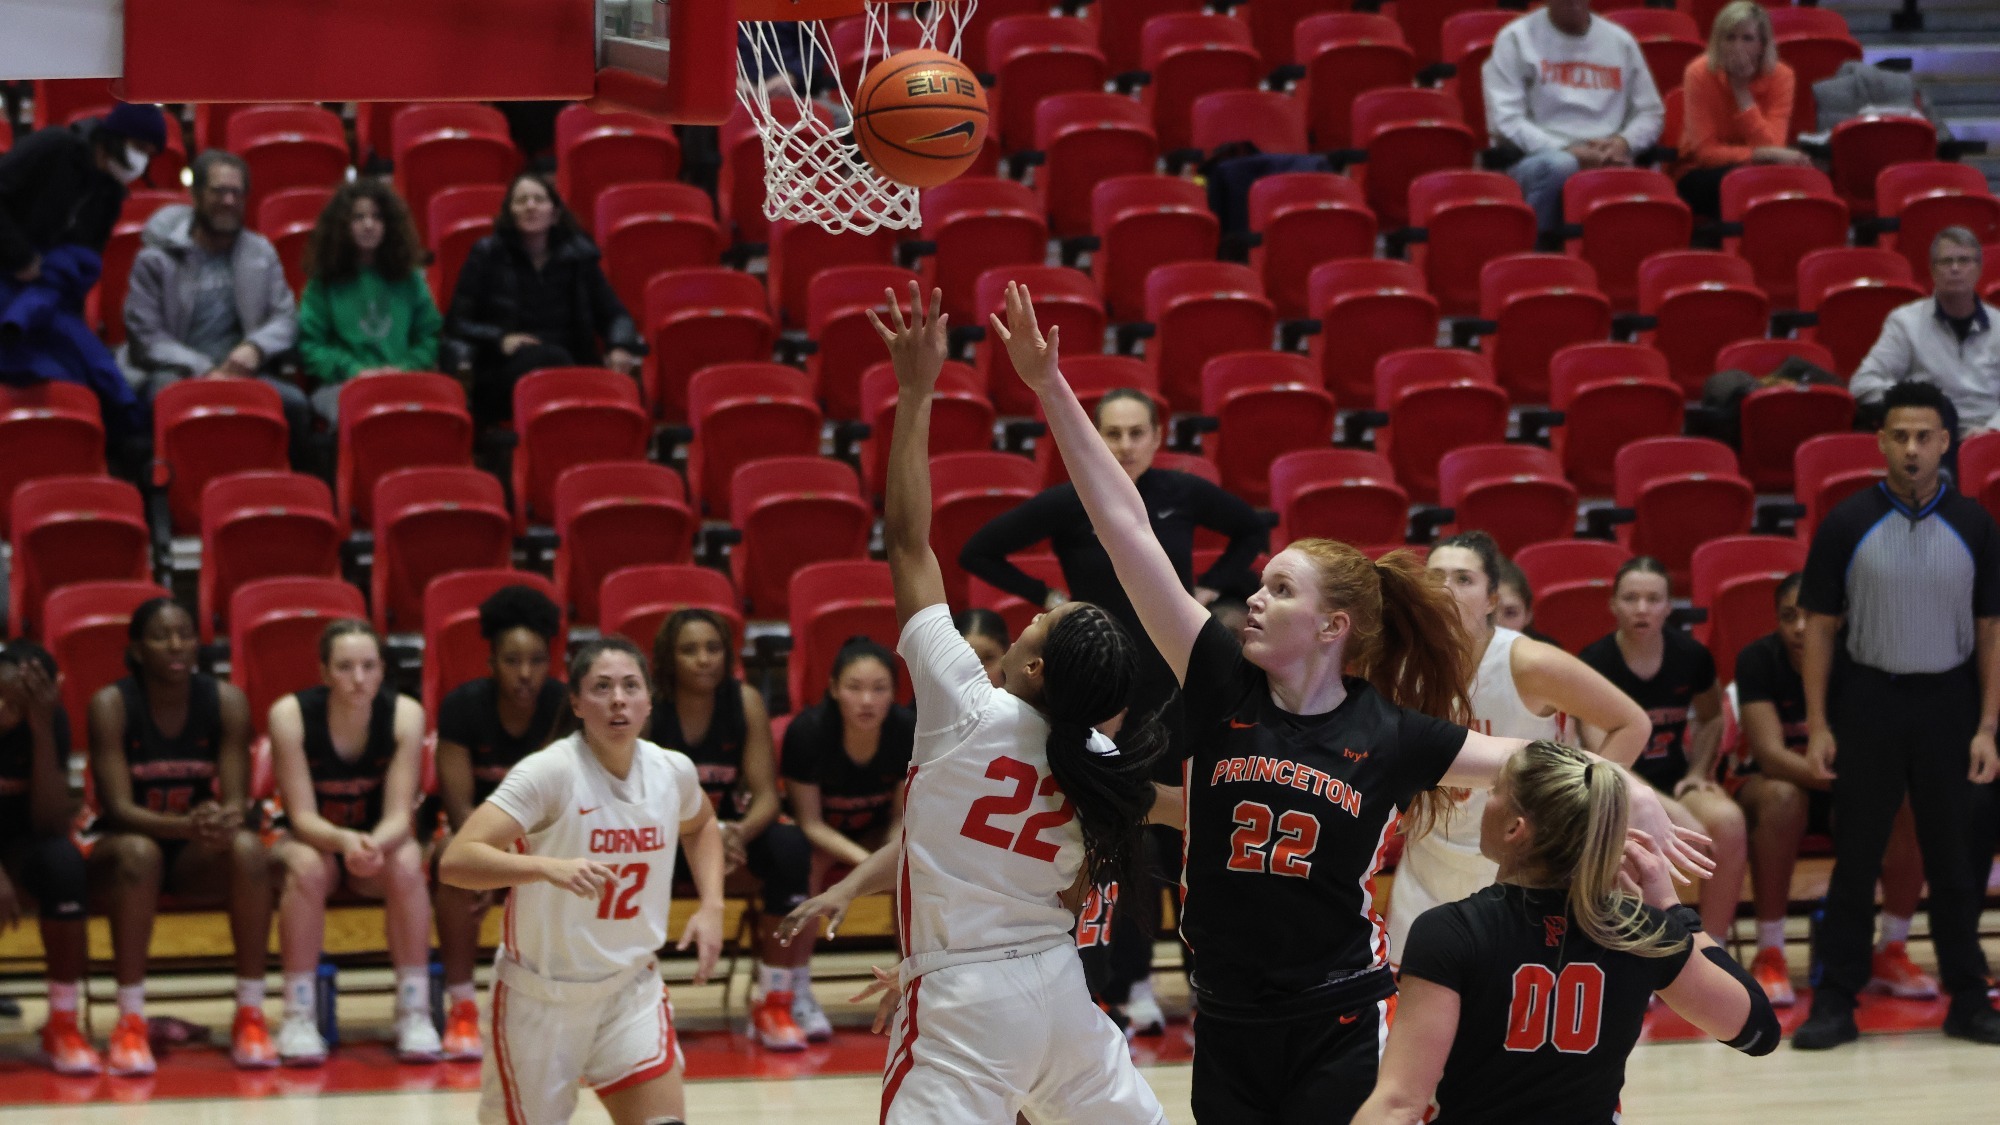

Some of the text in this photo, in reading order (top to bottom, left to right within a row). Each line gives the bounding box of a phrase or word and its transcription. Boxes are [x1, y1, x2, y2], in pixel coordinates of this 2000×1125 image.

[906, 76, 977, 98] ELITE
[959, 755, 1076, 863] 22
[1211, 755, 1362, 818] PRINCETON
[590, 826, 666, 854] CORNELL
[1226, 800, 1321, 880] 22
[596, 863, 650, 920] 12
[1543, 915, 1568, 947] P
[1503, 962, 1605, 1055] 00
